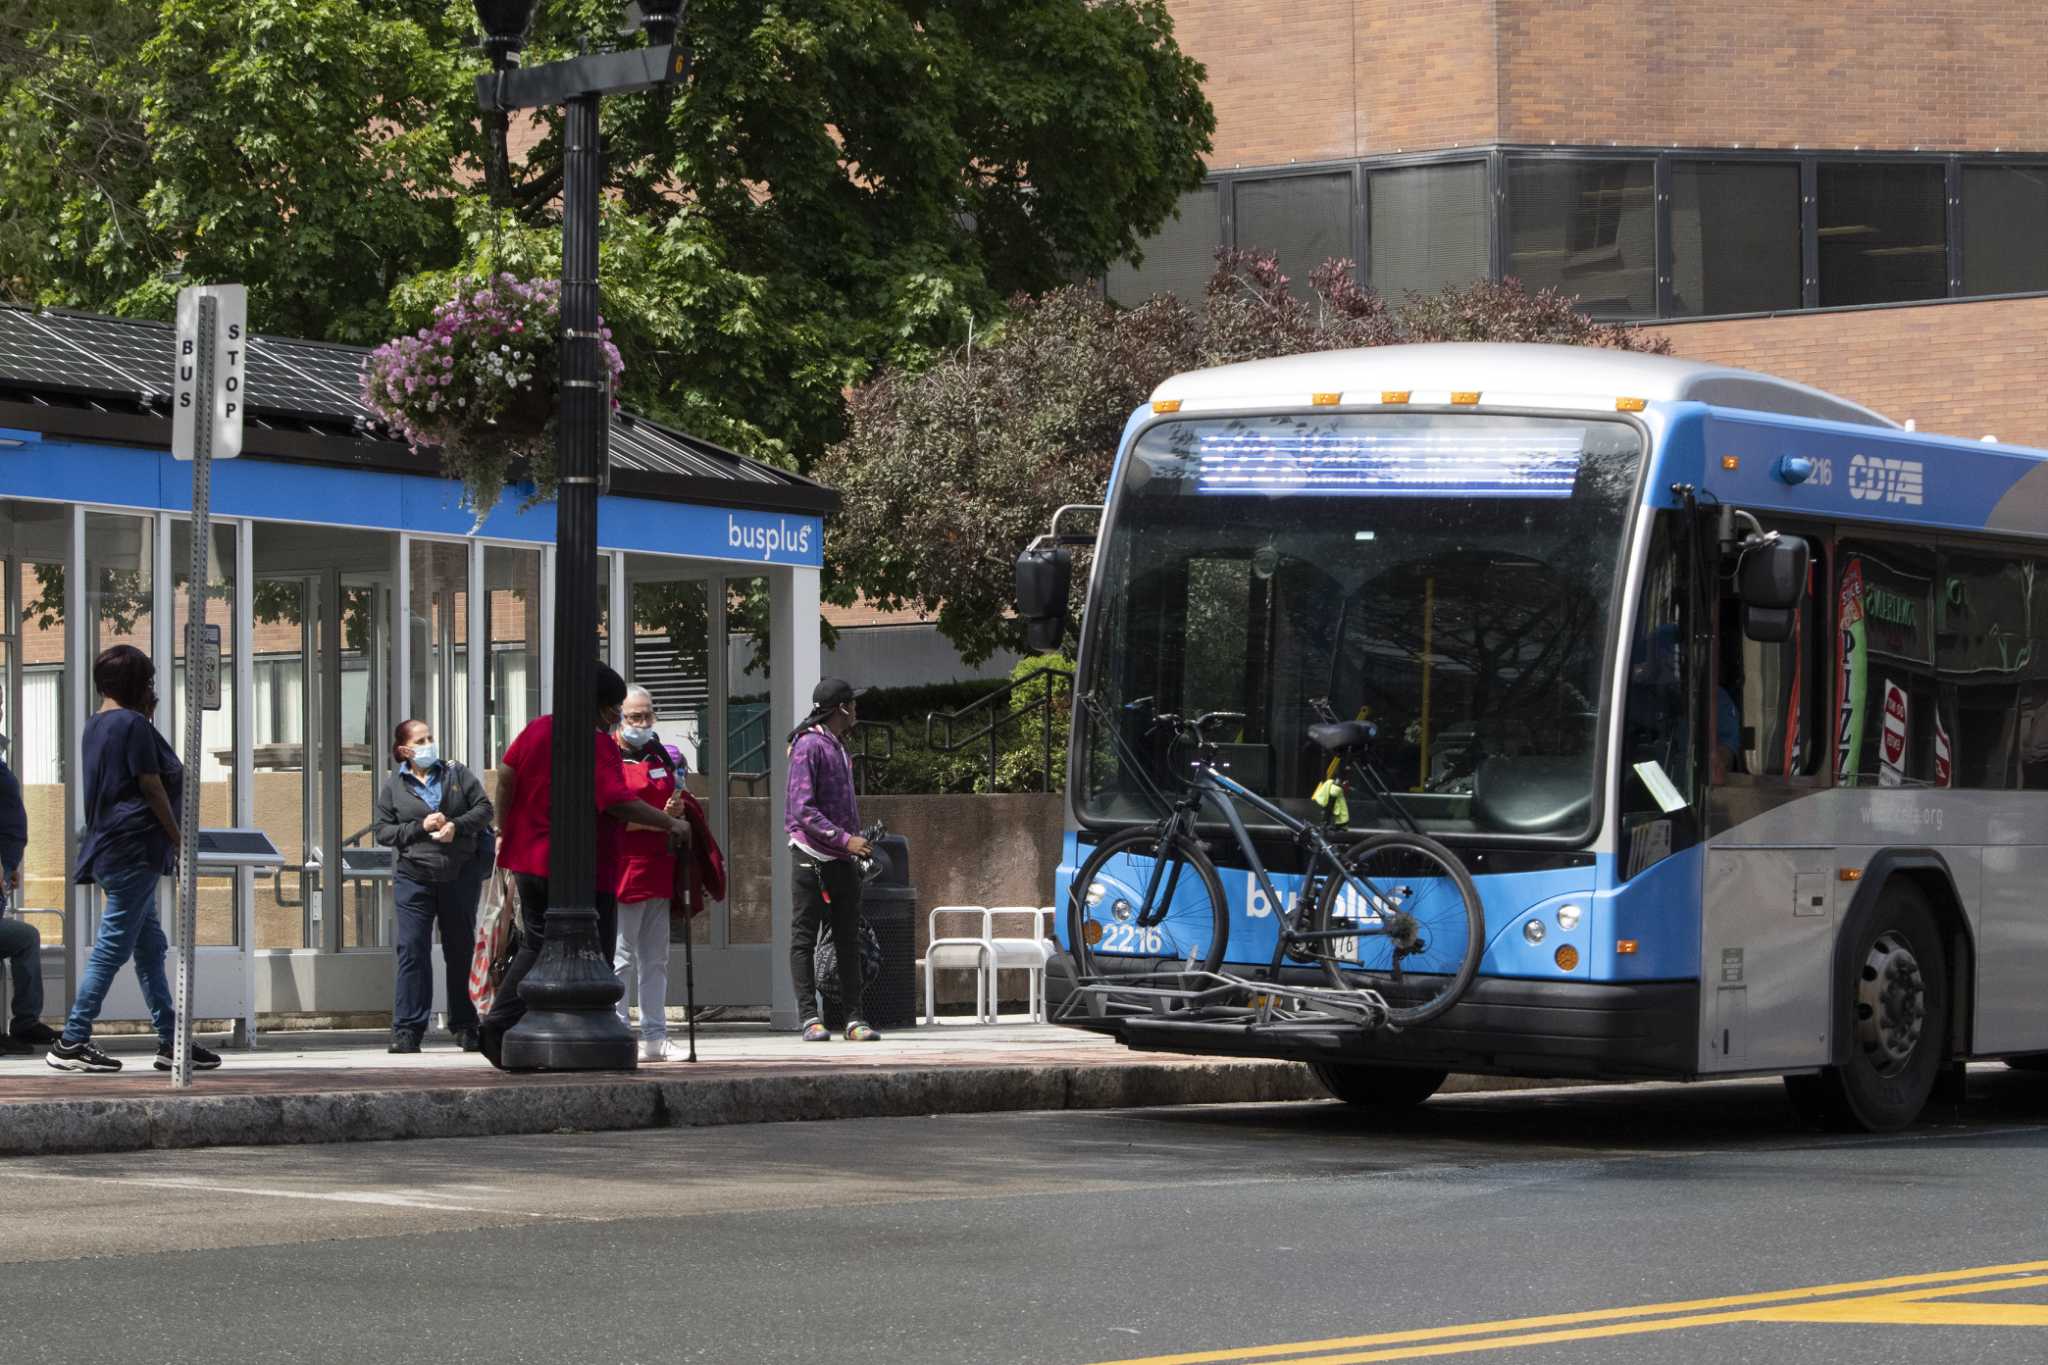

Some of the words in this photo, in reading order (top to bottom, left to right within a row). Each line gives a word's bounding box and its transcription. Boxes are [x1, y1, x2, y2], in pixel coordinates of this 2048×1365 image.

[180, 340, 193, 408] BUS
[225, 324, 240, 418] STOP
[1803, 455, 1832, 486] 216
[1848, 454, 1923, 505] CDTA
[728, 513, 810, 561] busplus
[1102, 923, 1162, 953] 2216
